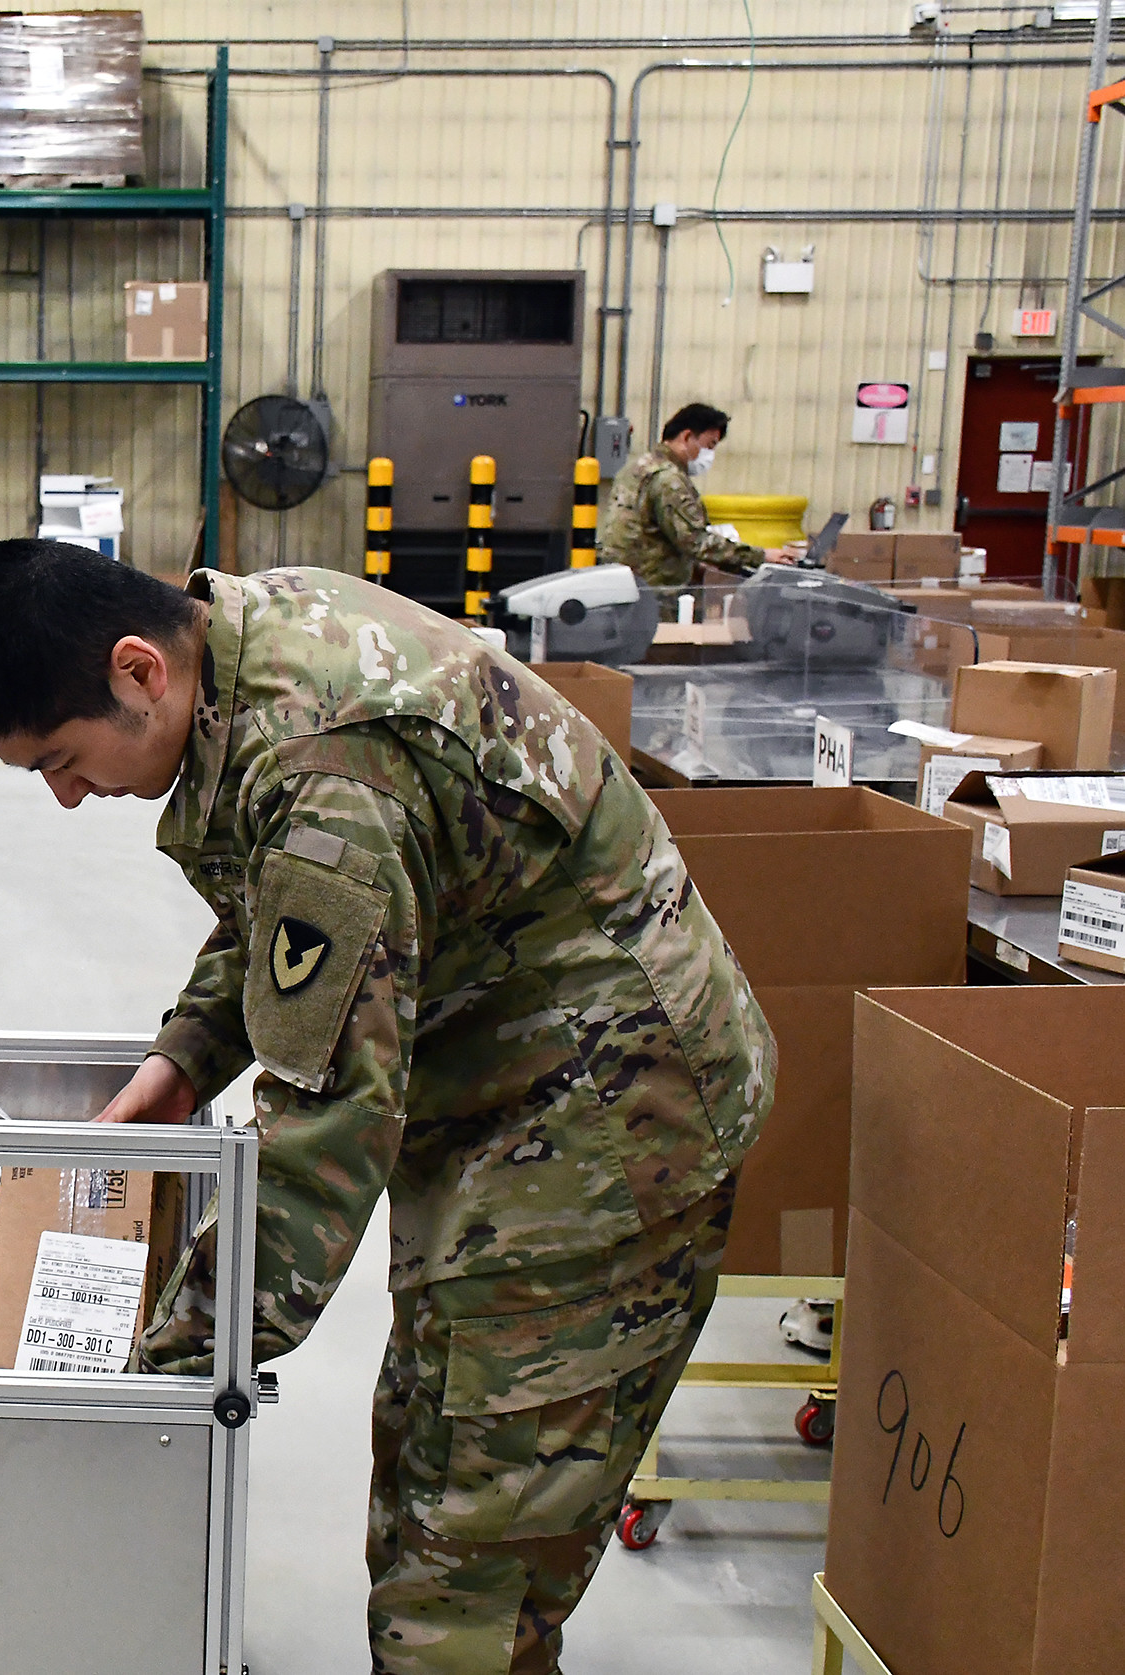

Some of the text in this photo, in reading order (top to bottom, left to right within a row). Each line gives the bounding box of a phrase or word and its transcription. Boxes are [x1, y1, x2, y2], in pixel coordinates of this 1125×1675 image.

[1021, 311, 1052, 334] EXIT
[467, 393, 508, 407] YORK
[818, 733, 846, 778] PHA
[105, 1340, 113, 1354] C
[876, 1369, 967, 1539] 906
